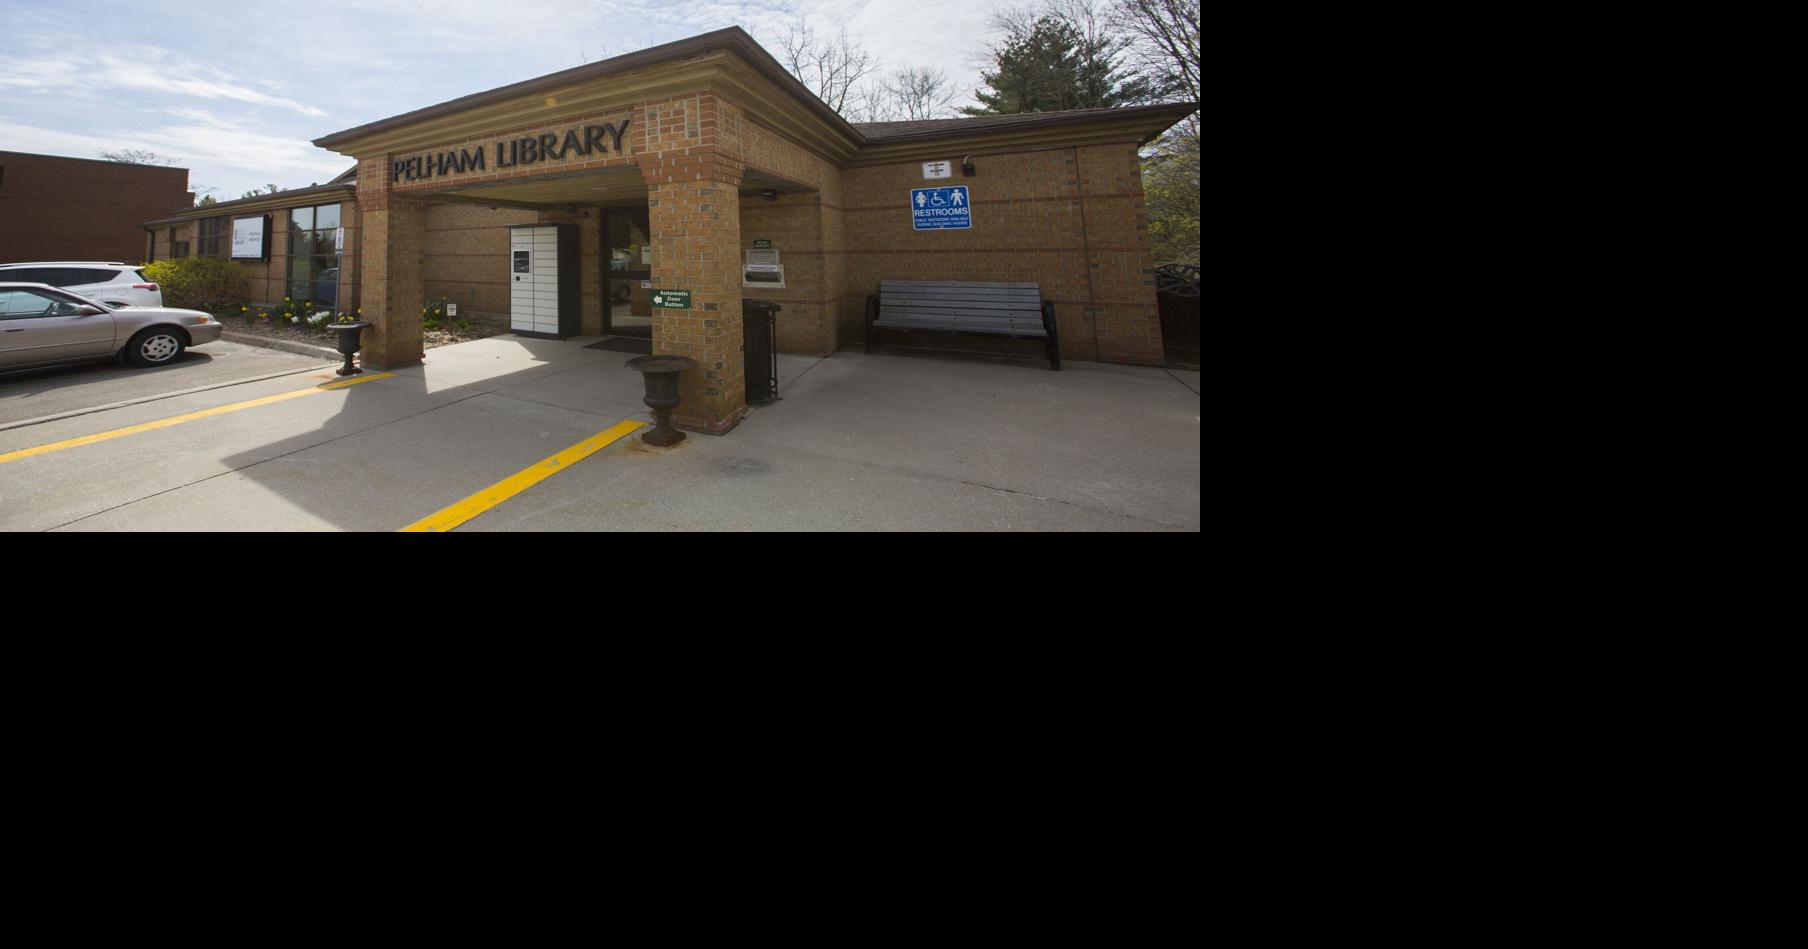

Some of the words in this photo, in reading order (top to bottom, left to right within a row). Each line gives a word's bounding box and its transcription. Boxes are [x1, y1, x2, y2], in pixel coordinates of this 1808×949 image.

[393, 145, 485, 182] PELHAM
[496, 119, 630, 168] LIBRARY
[914, 207, 968, 217] RESTROOMS
